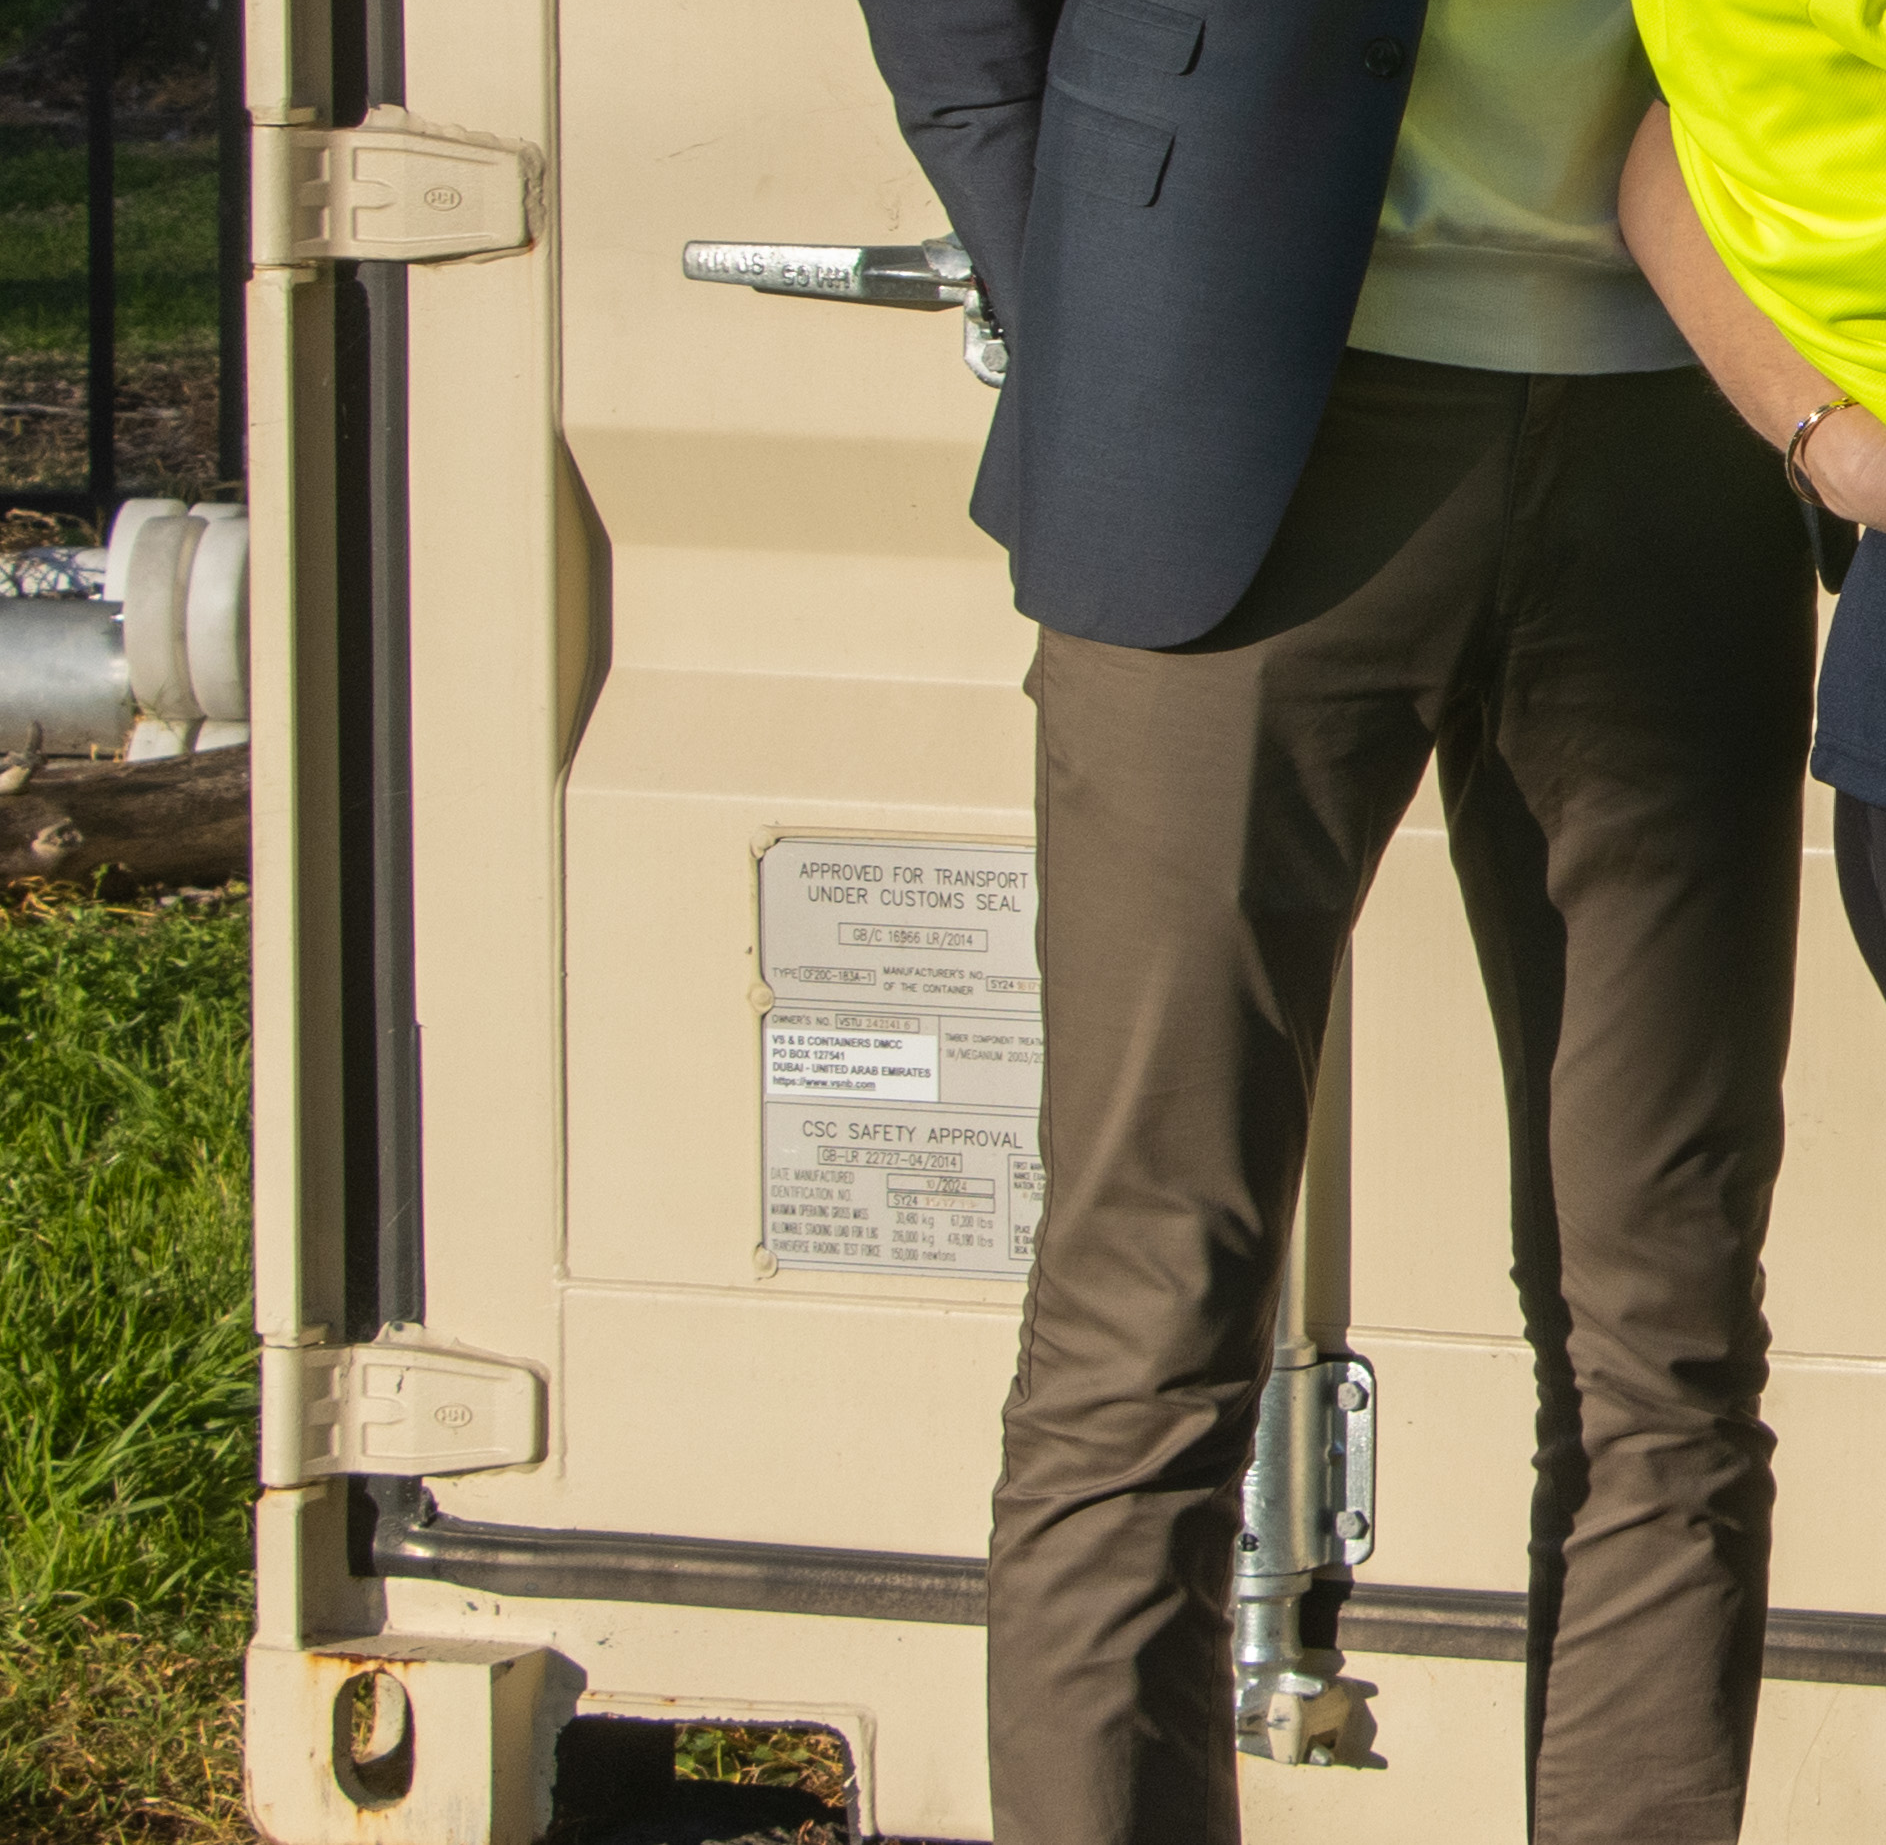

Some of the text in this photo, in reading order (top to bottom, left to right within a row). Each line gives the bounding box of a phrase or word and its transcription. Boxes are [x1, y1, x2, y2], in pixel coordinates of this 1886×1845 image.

[799, 862, 1029, 890] APPROVED FOR TRANSPORT
[807, 886, 1022, 913] UNDER CUSTOMS SEAL
[853, 928, 883, 945] GB/C
[926, 932, 974, 948] LR/2014
[772, 967, 798, 980] TYPE
[883, 966, 965, 980] MANUFACTURER'S
[883, 981, 974, 996] OF THE CONTAINER
[772, 1014, 812, 1025] OWNER'S
[807, 1037, 872, 1048] CONTAINERS
[873, 1039, 903, 1050] DMCC
[772, 1049, 787, 1058] PO
[789, 1050, 810, 1060] BOX
[772, 1063, 931, 1078] DUBAI UNITED ARAB EMIRATES
[802, 1120, 1024, 1149] CSC SAFETY APPROVAL
[771, 1167, 855, 1185] DATE MANUFACTURED
[771, 1185, 834, 1200] IDENTIFICATION
[893, 1193, 918, 1207] SY24
[921, 1214, 935, 1228] kg
[921, 1232, 935, 1246] kg
